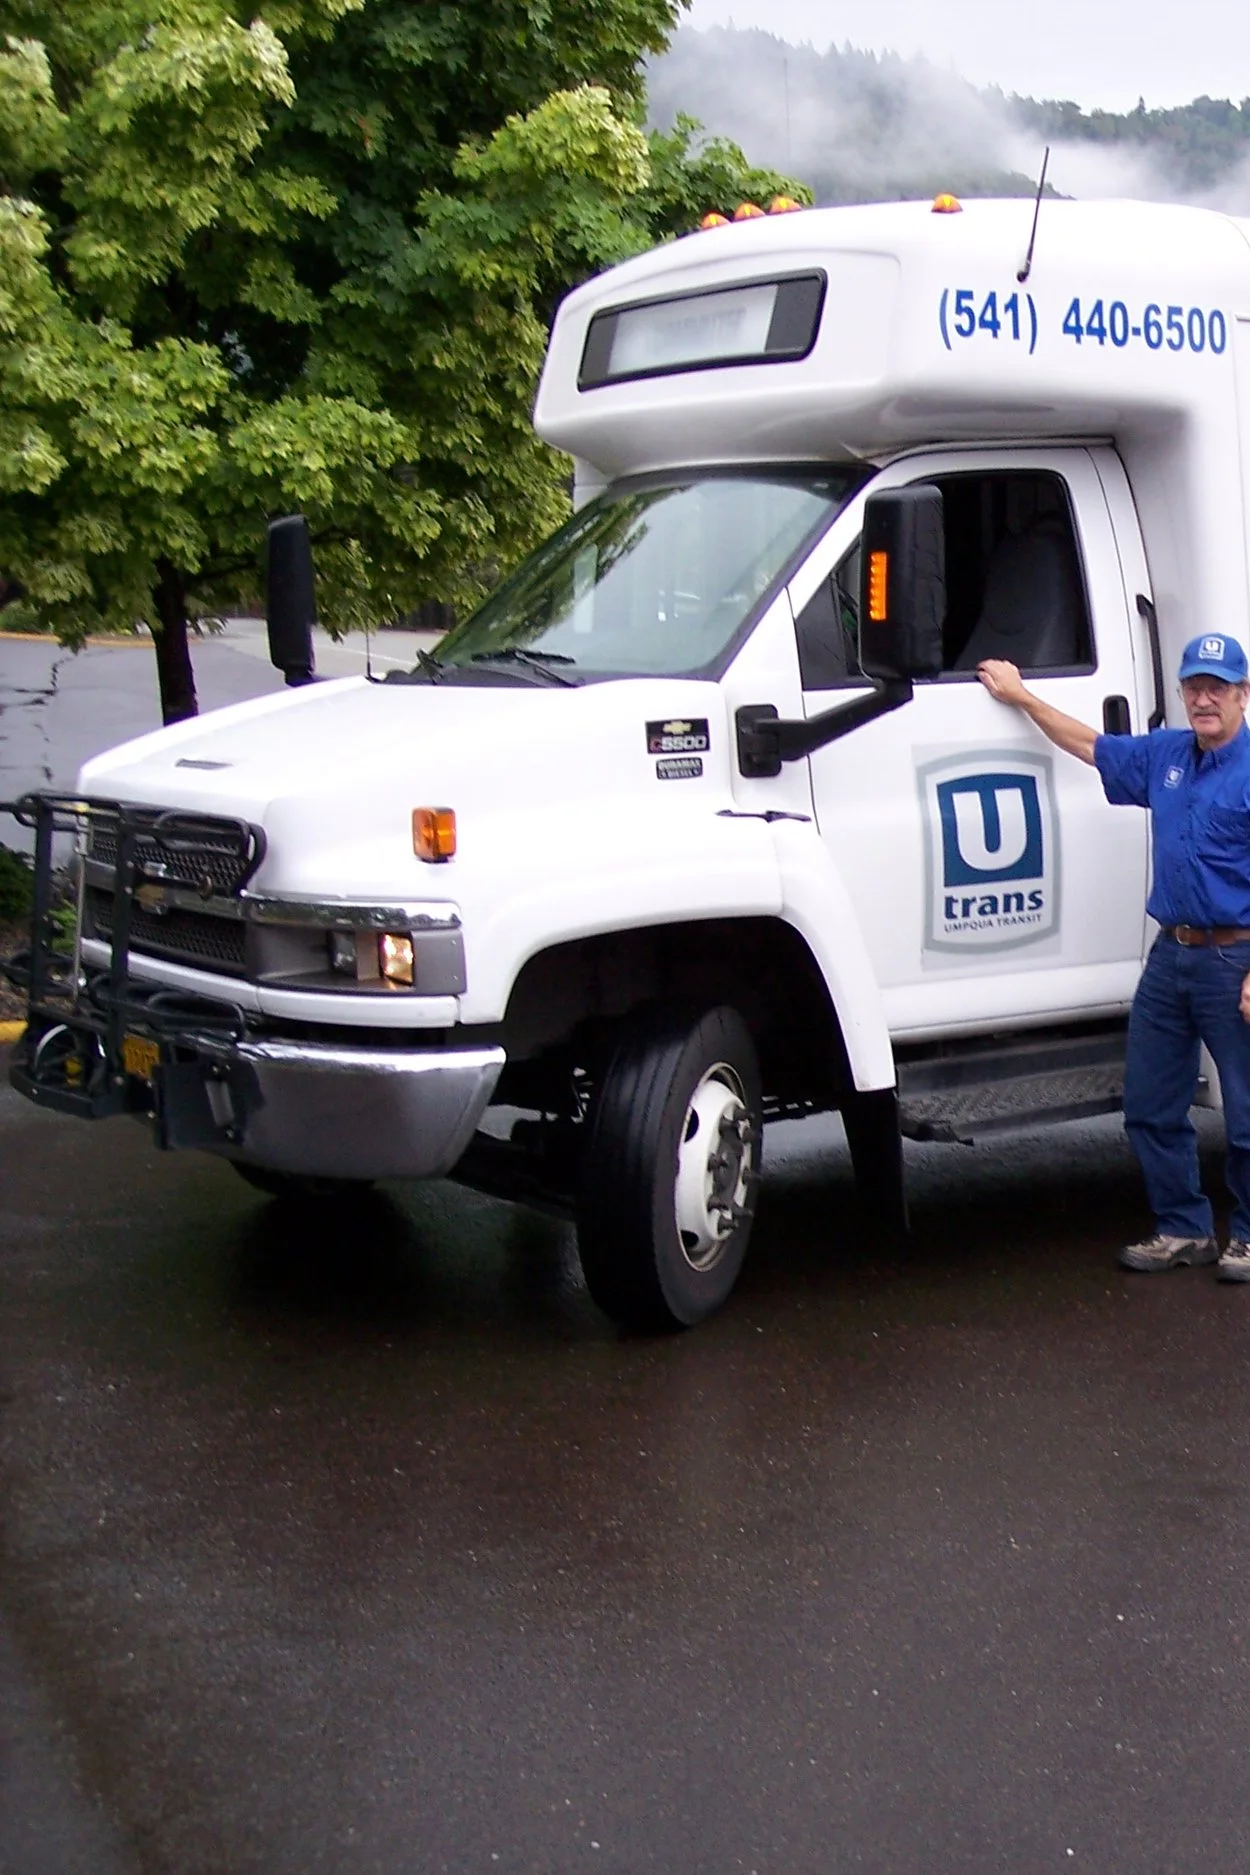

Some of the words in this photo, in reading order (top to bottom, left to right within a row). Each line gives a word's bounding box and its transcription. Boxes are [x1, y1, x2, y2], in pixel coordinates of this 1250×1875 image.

[939, 288, 1038, 355] (541)
[1062, 297, 1227, 354] 440-6500
[952, 788, 1028, 871] U
[944, 918, 994, 933] UMPQUA
[997, 913, 1043, 928] TRANSIT
[945, 889, 1044, 919] trans
